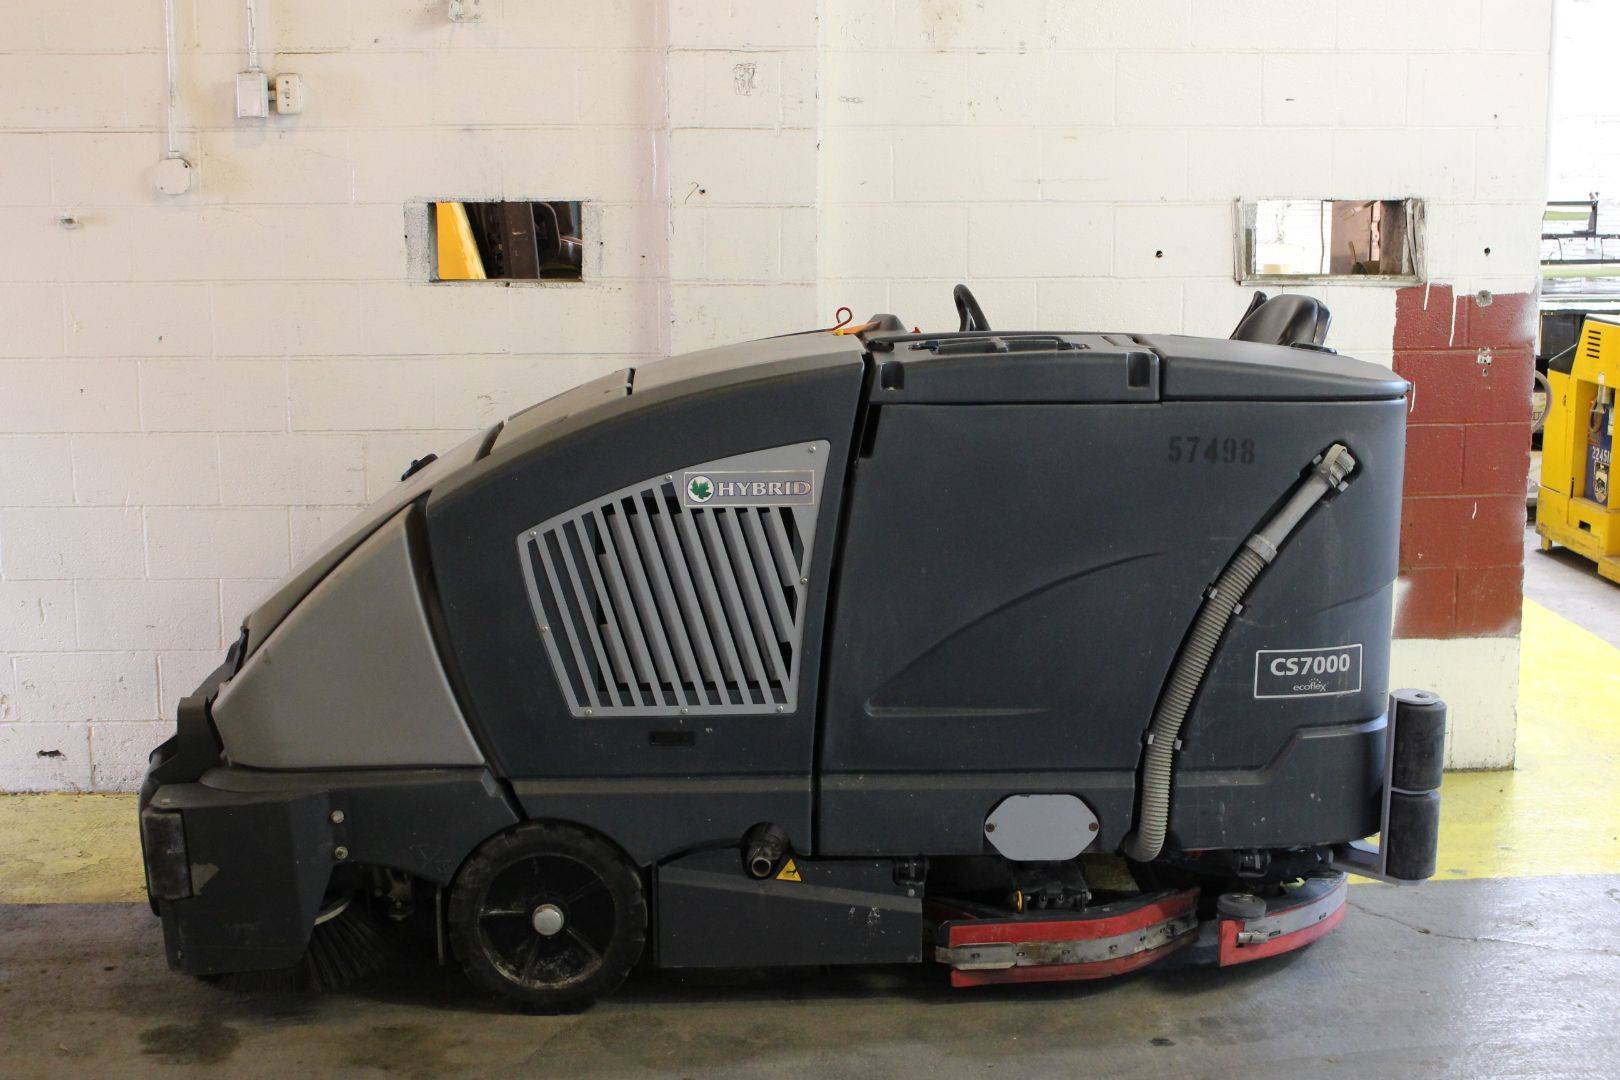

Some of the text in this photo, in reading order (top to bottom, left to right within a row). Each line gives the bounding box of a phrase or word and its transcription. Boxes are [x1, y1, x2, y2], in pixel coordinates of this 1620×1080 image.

[1168, 436, 1256, 464] 57498
[718, 481, 812, 496] HYBRID
[1270, 654, 1350, 676] CS7000
[1293, 681, 1327, 692] ecoflex
